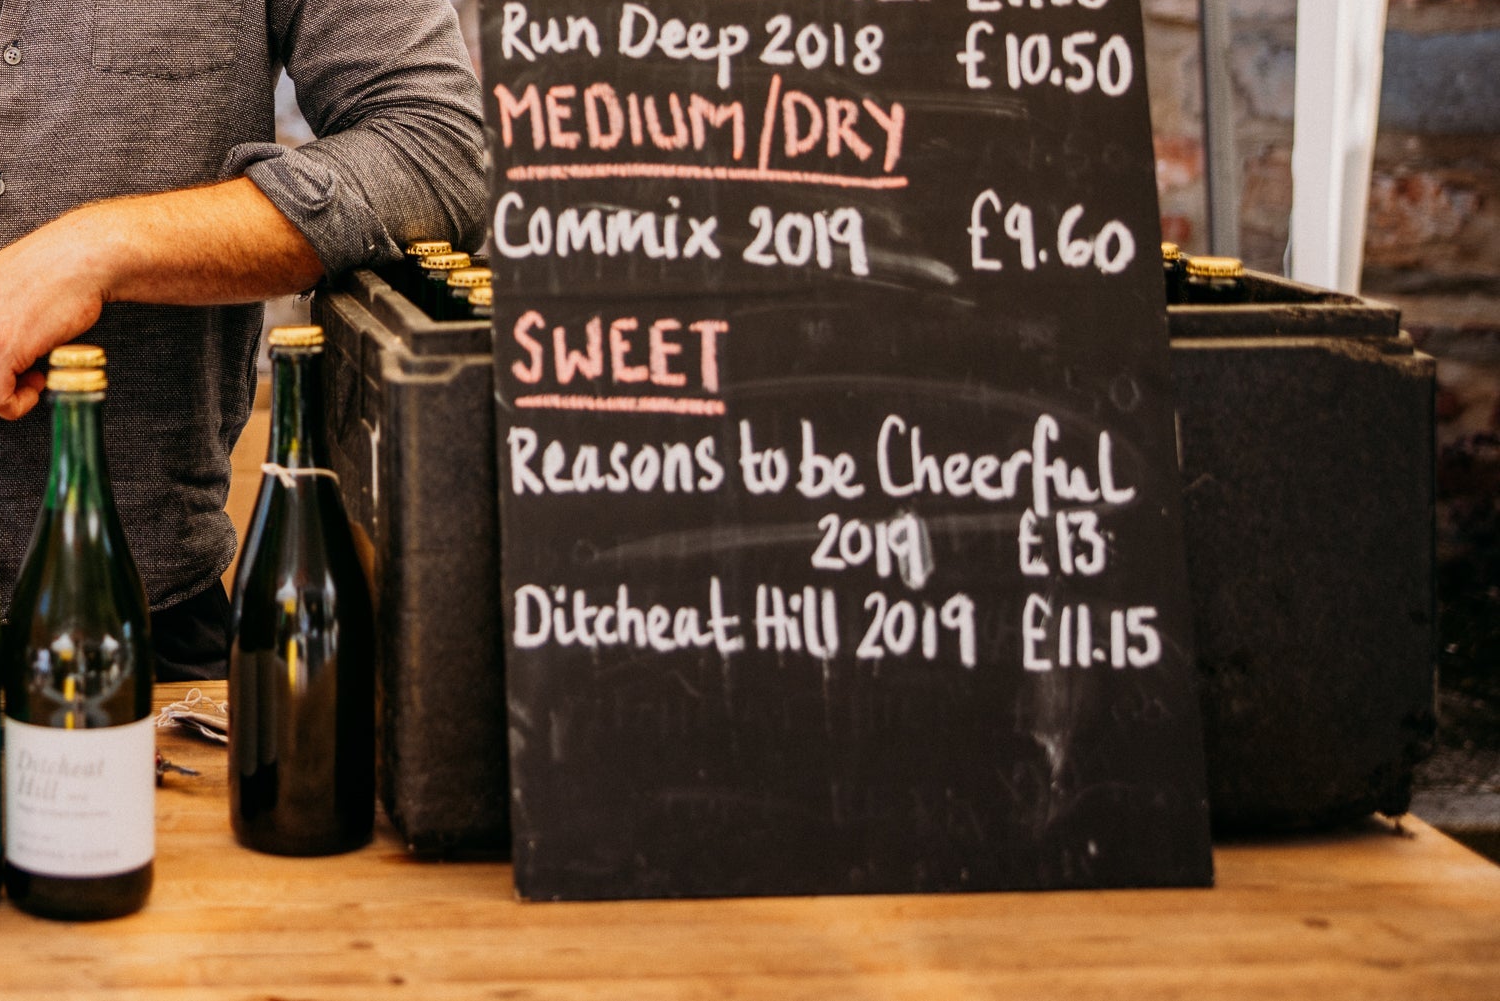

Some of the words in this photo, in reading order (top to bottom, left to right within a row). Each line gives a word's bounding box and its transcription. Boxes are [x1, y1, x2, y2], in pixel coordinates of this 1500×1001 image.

[500, 3, 602, 64] Run
[618, 3, 750, 89] Deep
[760, 13, 885, 77] 2018
[956, 20, 1134, 97] £10.50
[493, 192, 722, 261] Commix
[742, 205, 870, 277] 2019
[966, 189, 1137, 274] £9.60
[511, 310, 730, 394] SWEET
[507, 426, 725, 495] Reasons
[739, 419, 788, 496] to
[800, 419, 865, 499] be
[876, 414, 1136, 518] Cheerful
[811, 512, 928, 580] 2019
[1017, 509, 1106, 577] £13
[512, 576, 745, 653] Ditcheat
[754, 584, 838, 658] Hill
[856, 592, 977, 668] 2019
[1021, 593, 1163, 671] £11.15
[16, 774, 58, 801] Hill
